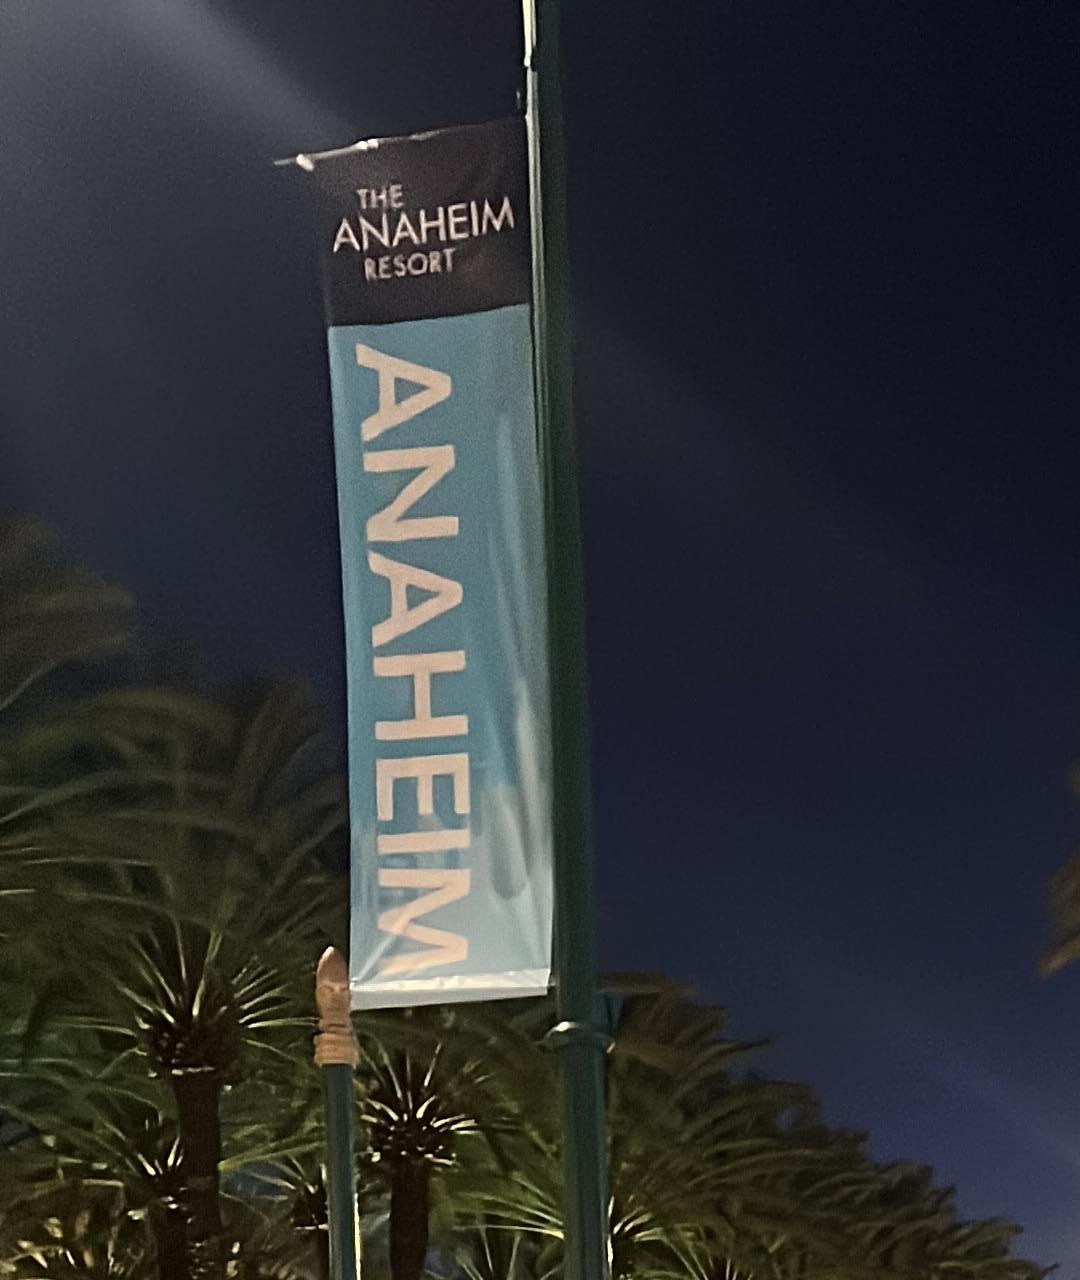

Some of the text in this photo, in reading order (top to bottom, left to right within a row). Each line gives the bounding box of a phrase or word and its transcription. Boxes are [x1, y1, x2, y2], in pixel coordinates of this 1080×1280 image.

[355, 184, 406, 210] THE
[333, 196, 515, 253] ANAHEIM
[363, 247, 457, 281] RESORT
[355, 342, 472, 974] ANAHEIM
